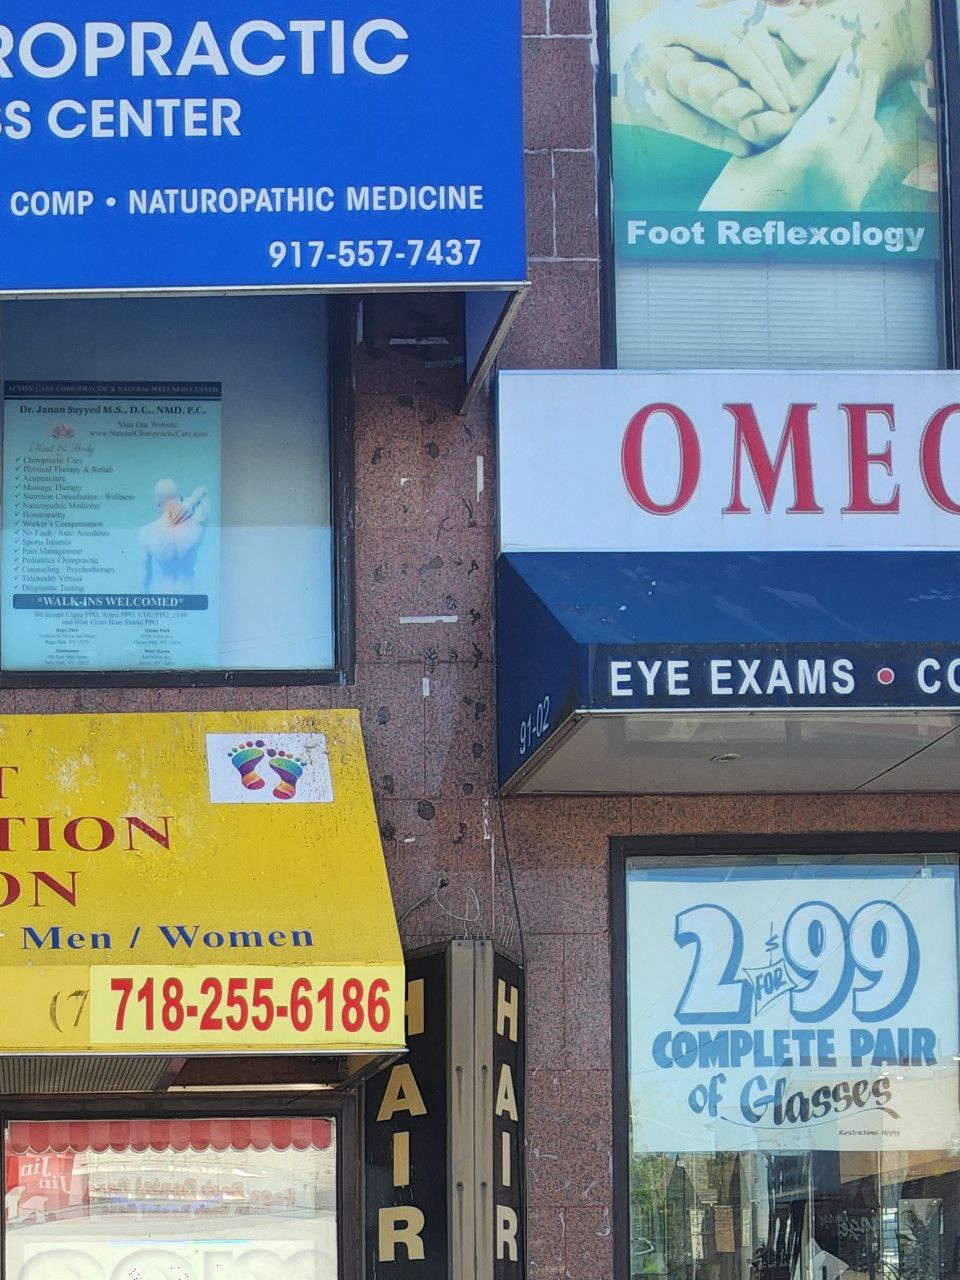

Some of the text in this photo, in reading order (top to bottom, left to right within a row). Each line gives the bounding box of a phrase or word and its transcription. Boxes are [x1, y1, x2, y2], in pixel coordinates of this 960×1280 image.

[48, 98, 241, 138] CENTER
[10, 189, 94, 217] COMP
[128, 186, 335, 214] NATUROPATHIC
[346, 185, 483, 211] MEDICINE
[269, 239, 482, 269] 917-557-7437
[627, 220, 925, 252] Foot Reflexology
[20, 405, 34, 416] Dr.
[610, 658, 690, 697] EYE
[711, 658, 855, 696] EXAMS
[520, 695, 550, 755] 91-02
[21, 926, 112, 949] Men
[130, 926, 141, 949] /
[158, 925, 314, 948] Women
[674, 903, 751, 1025] 2
[755, 967, 784, 1000] FOR
[110, 977, 391, 1032] 718-255-6186
[652, 1028, 937, 1068] COMPLETE PAIR
[688, 1073, 892, 1126] of Glasses
[495, 978, 519, 1263] HAIR
